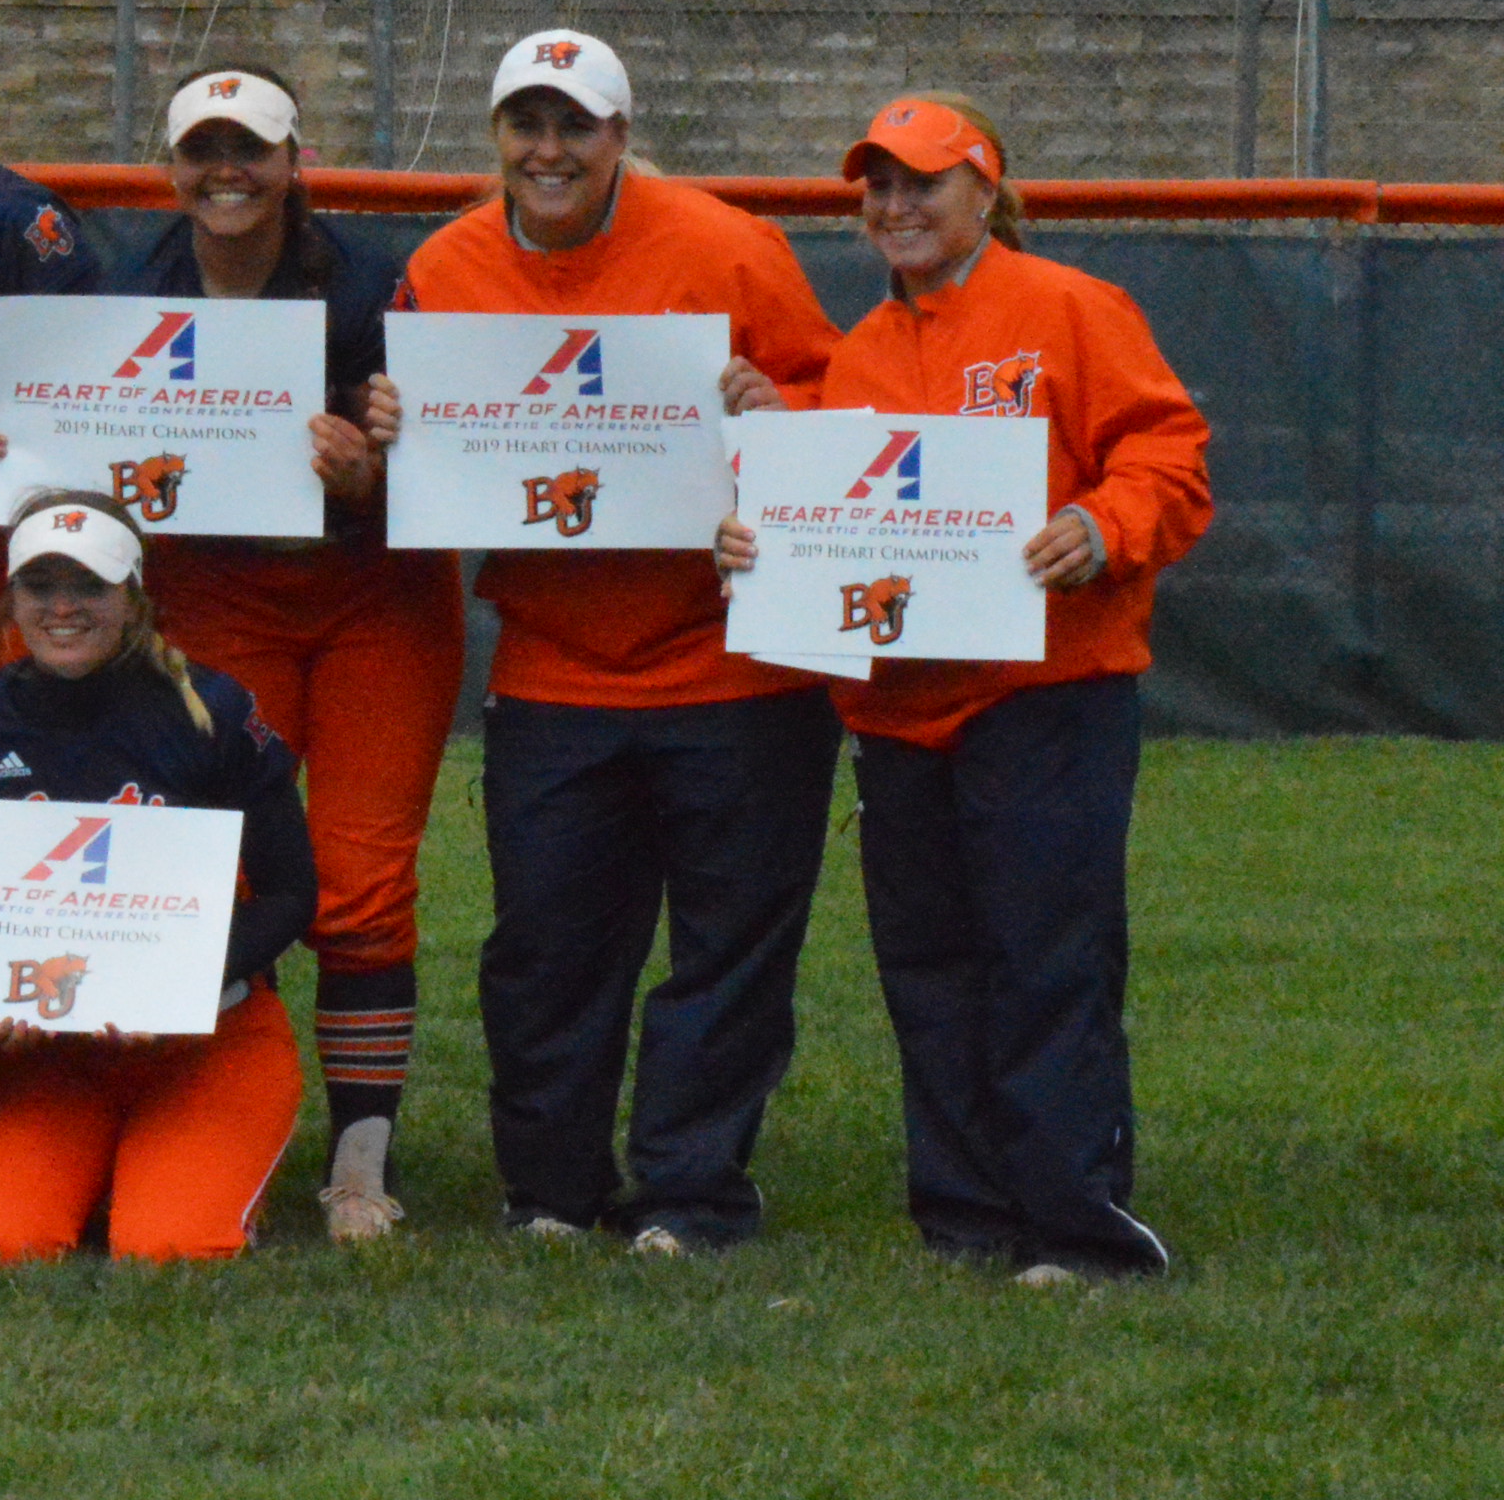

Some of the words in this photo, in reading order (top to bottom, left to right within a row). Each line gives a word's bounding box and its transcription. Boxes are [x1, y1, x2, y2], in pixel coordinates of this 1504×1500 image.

[16, 381, 112, 400] HEART
[118, 386, 147, 398] OF
[151, 387, 293, 407] AMERICA
[421, 401, 521, 419] HEART
[528, 403, 557, 415] OF
[561, 404, 699, 421] AMERICA
[54, 420, 90, 434] 2019
[95, 422, 145, 436] HEART
[153, 425, 256, 440] CHAMPIONS
[463, 439, 500, 452] 2019
[506, 440, 557, 453] HEART
[565, 440, 666, 454] CHAMPIONS
[759, 505, 845, 523] HEART
[850, 507, 876, 520] OF
[879, 508, 1015, 527] AMERICA
[791, 544, 823, 557] 2019
[828, 544, 874, 558] HEART
[881, 546, 978, 561] CHAMPIONS
[25, 888, 56, 900] OF
[59, 890, 201, 913] AMERICA
[57, 926, 162, 943] CHAMPIONS
